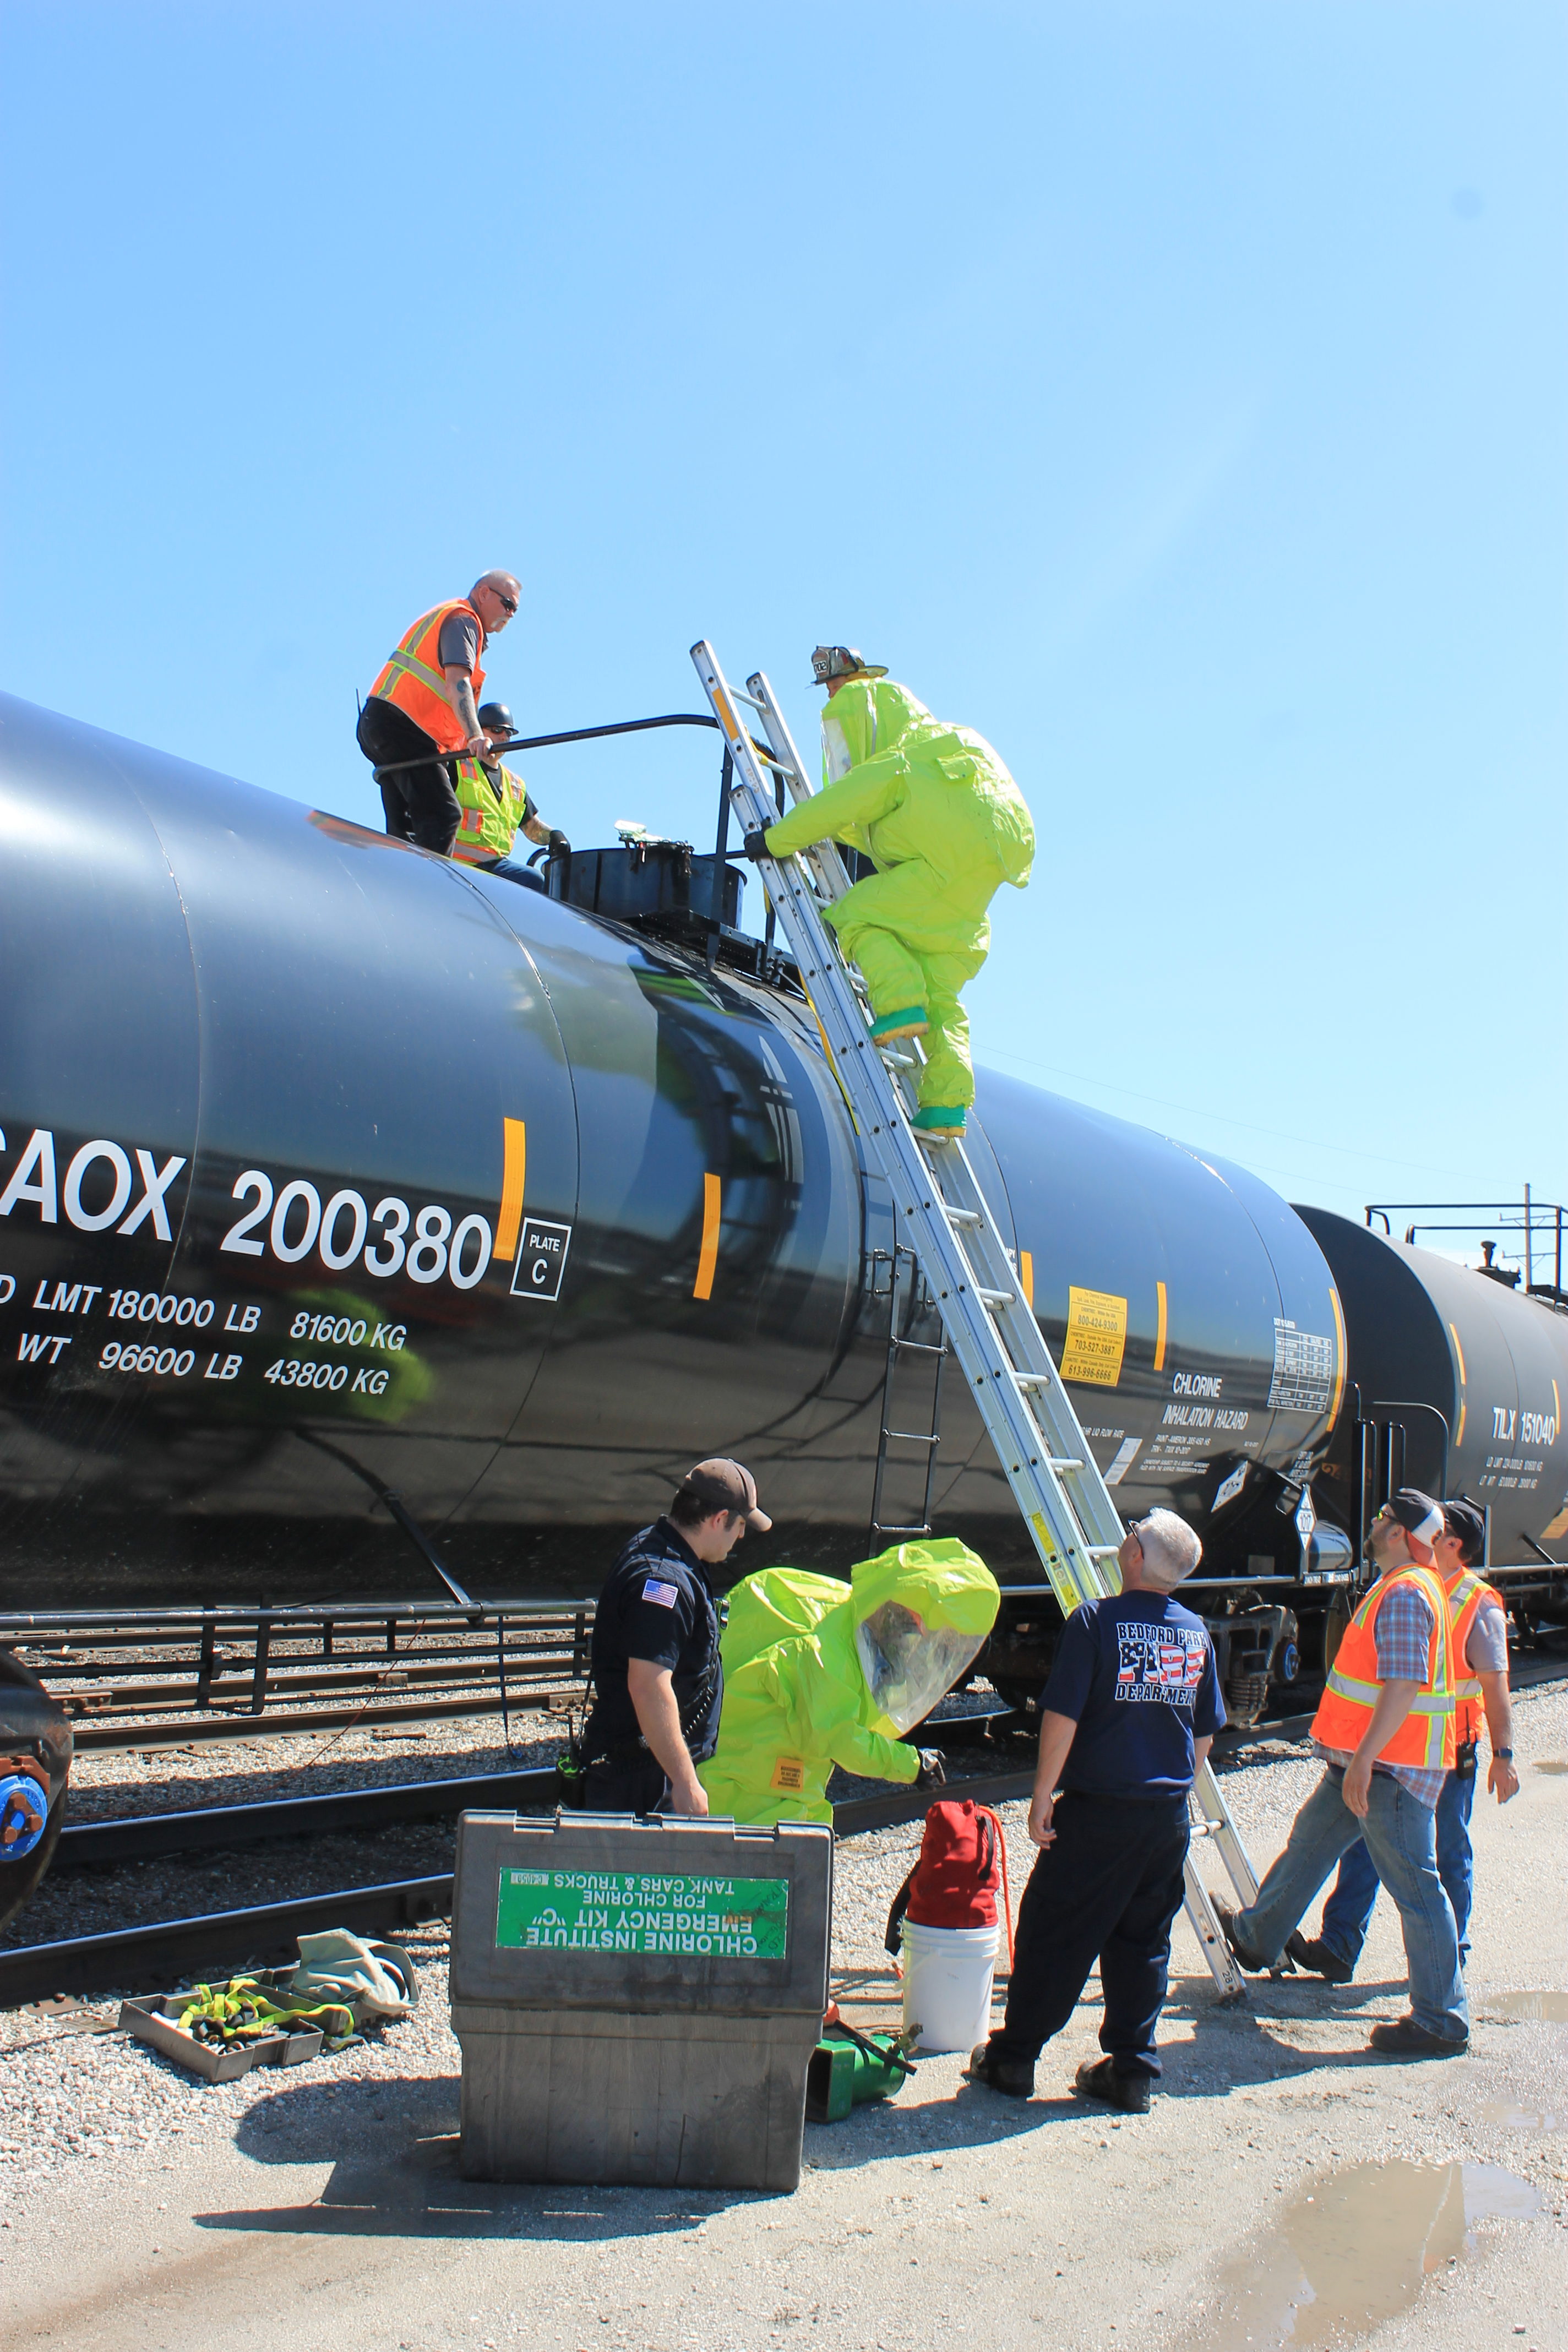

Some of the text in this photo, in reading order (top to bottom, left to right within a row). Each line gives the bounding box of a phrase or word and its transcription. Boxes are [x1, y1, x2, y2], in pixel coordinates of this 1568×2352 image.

[0, 1126, 492, 1289] AOX 200380
[529, 1234, 560, 1253] PLATE
[531, 1258, 548, 1284] C
[0, 1274, 407, 1351] D LMT 180000 LB 81600 KG
[1078, 1315, 1118, 1331] 800-424-9300
[1075, 1340, 1115, 1355] 703-527-3887
[17, 1333, 389, 1395] WT 96600 LB 43800 KG
[1068, 1365, 1112, 1380] 613-996-6666
[1172, 1372, 1223, 1398] CHLORINE
[1162, 1404, 1250, 1430] INHALATION HAZARD
[1493, 1406, 1555, 1446] TILX 151040
[1300, 1514, 1311, 1530] 1017
[1117, 1623, 1209, 1647] BEDFORD PARK
[1118, 1640, 1206, 1687] FIRE
[554, 1874, 734, 1895] TANK CARS & TRUCKS
[582, 1890, 706, 1909] FOR CHLORINE
[574, 1909, 608, 1928] KIT
[616, 1910, 753, 1934] EMERGENCY
[526, 1926, 758, 1954] CHLORINE INSTITUTE
[1222, 1970, 1233, 1983] 28
